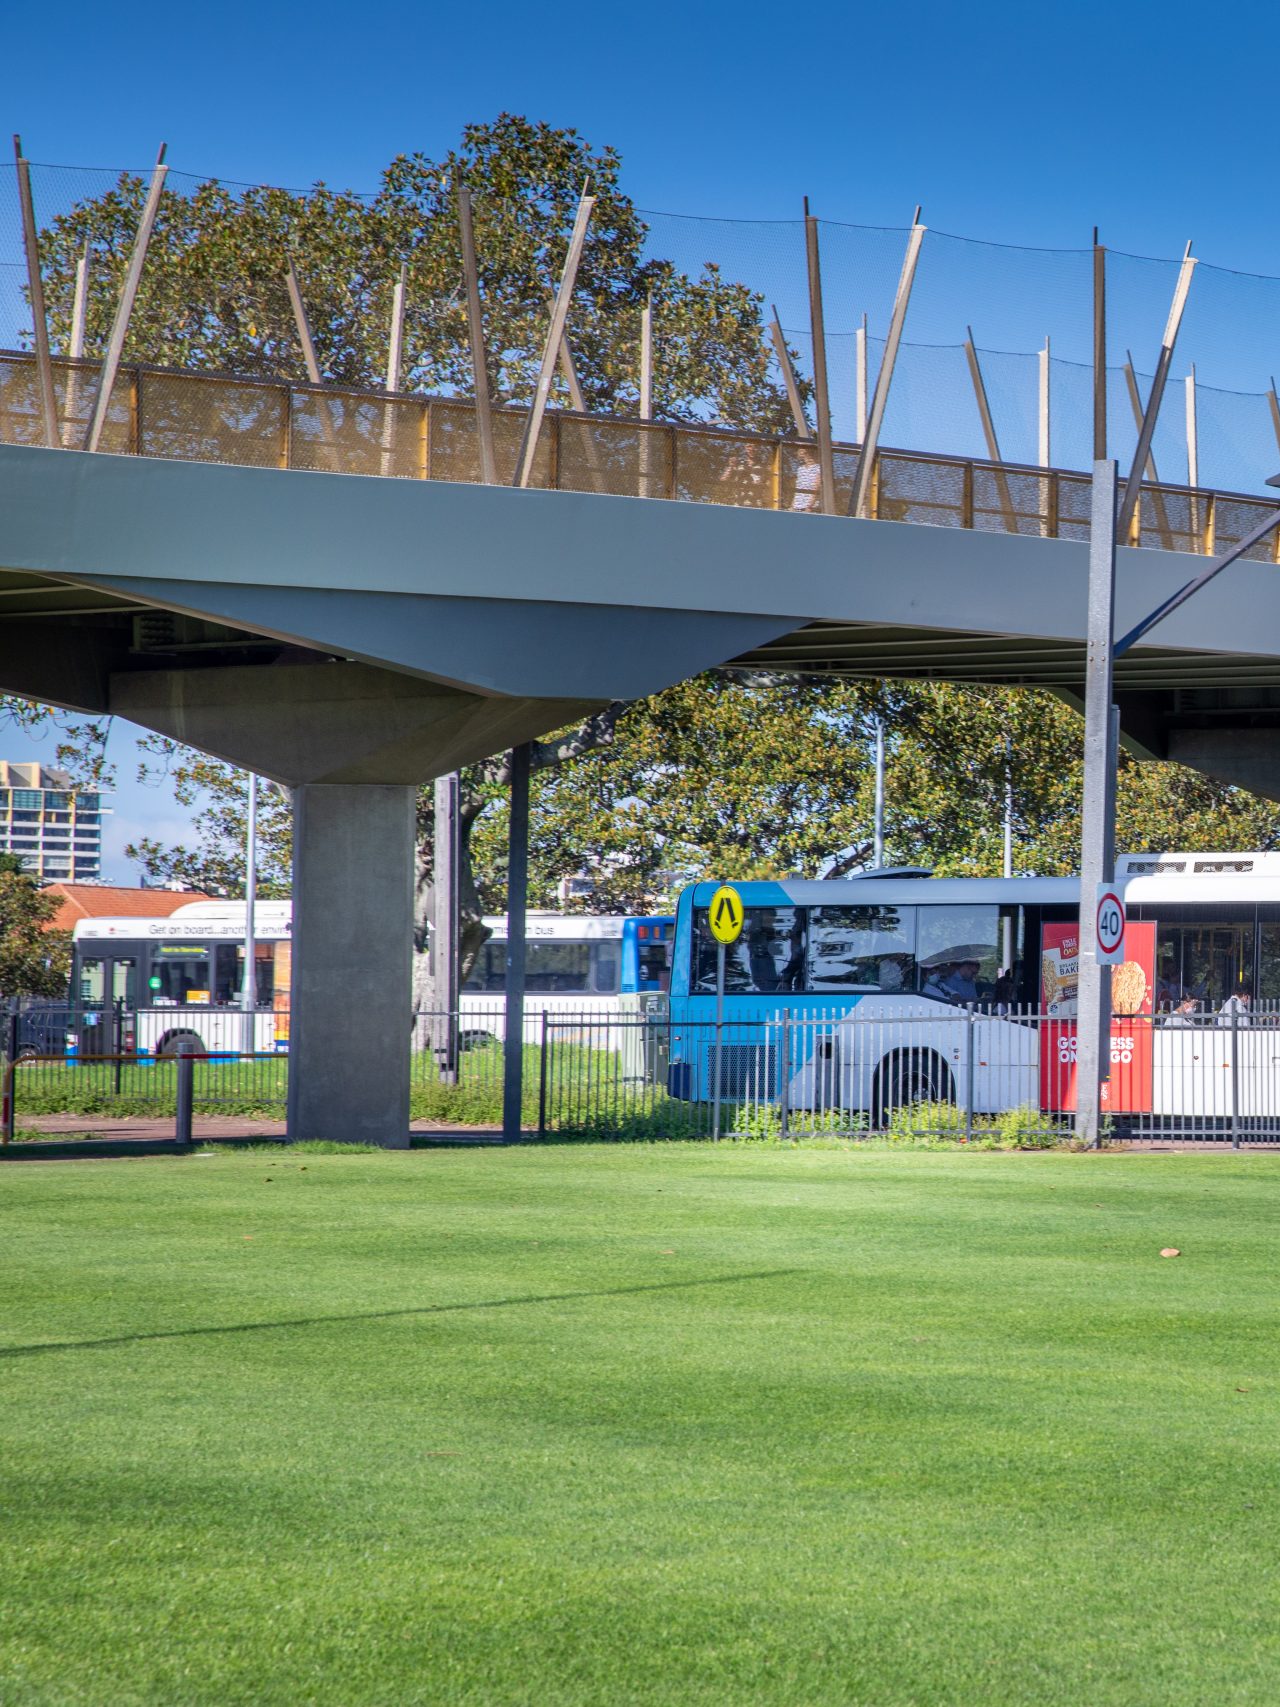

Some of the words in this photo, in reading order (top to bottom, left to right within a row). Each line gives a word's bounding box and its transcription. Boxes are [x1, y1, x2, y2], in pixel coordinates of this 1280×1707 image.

[1100, 911, 1119, 936] 40
[1058, 1036, 1135, 1050] GOESS
[1110, 1050, 1133, 1064] GO
